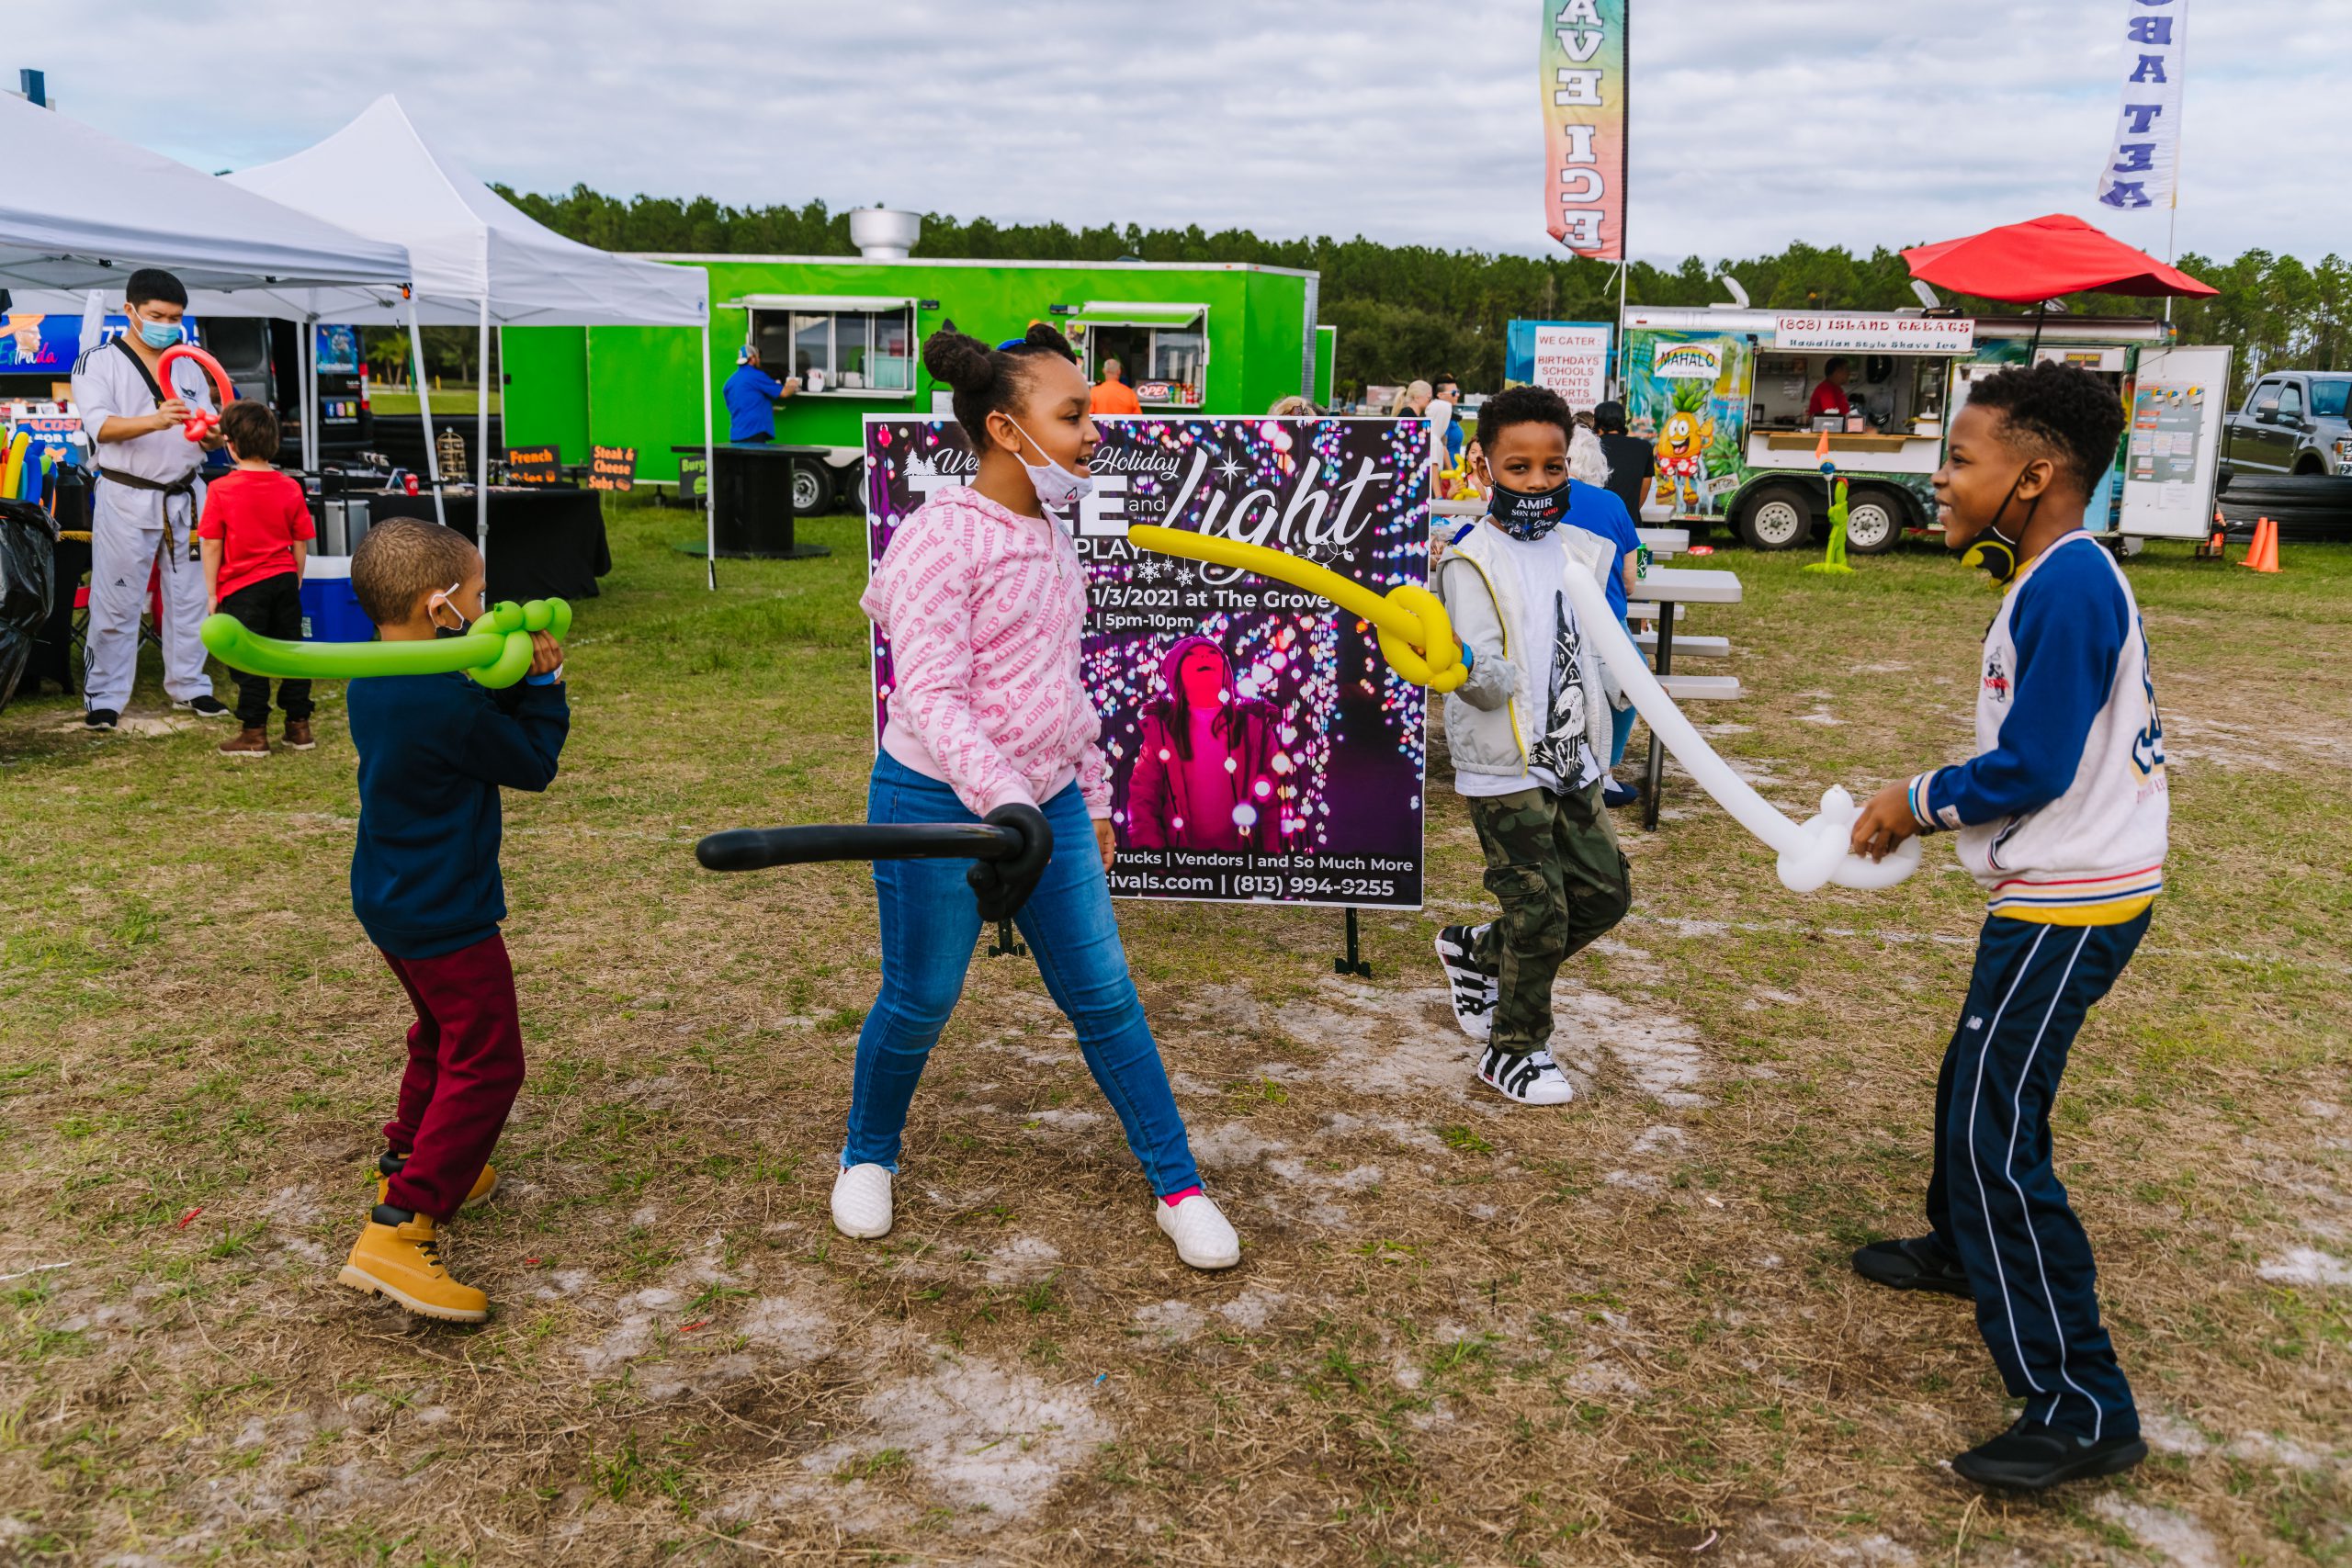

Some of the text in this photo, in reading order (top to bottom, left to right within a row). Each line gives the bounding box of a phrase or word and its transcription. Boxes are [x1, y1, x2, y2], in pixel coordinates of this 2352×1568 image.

[1780, 319, 1970, 333] (808) ISLAND TREATS
[1539, 336, 1555, 344] WE
[1790, 339, 1850, 347] Hawaiian
[1538, 356, 1600, 366] BIRTHDAYS
[1660, 351, 1716, 367] MAHALO
[1542, 367, 1594, 376] SCHOOLS
[1547, 378, 1590, 387] EVENTS
[510, 448, 553, 465] French
[594, 446, 623, 460] Steak
[594, 460, 631, 475] Cheese
[1088, 446, 1182, 480] Holiday
[588, 475, 614, 491] Subs
[1129, 496, 1166, 512] and
[1517, 497, 1553, 509] AMIR
[1185, 591, 1208, 607] at
[1215, 590, 1256, 608] The
[1263, 590, 1331, 608] Grove
[1105, 613, 1193, 631] 5pm-10pm
[1114, 851, 1413, 872] rucks Vendors and So Much More
[1233, 874, 1283, 897] (813)
[1290, 877, 1395, 897] 994-9255
